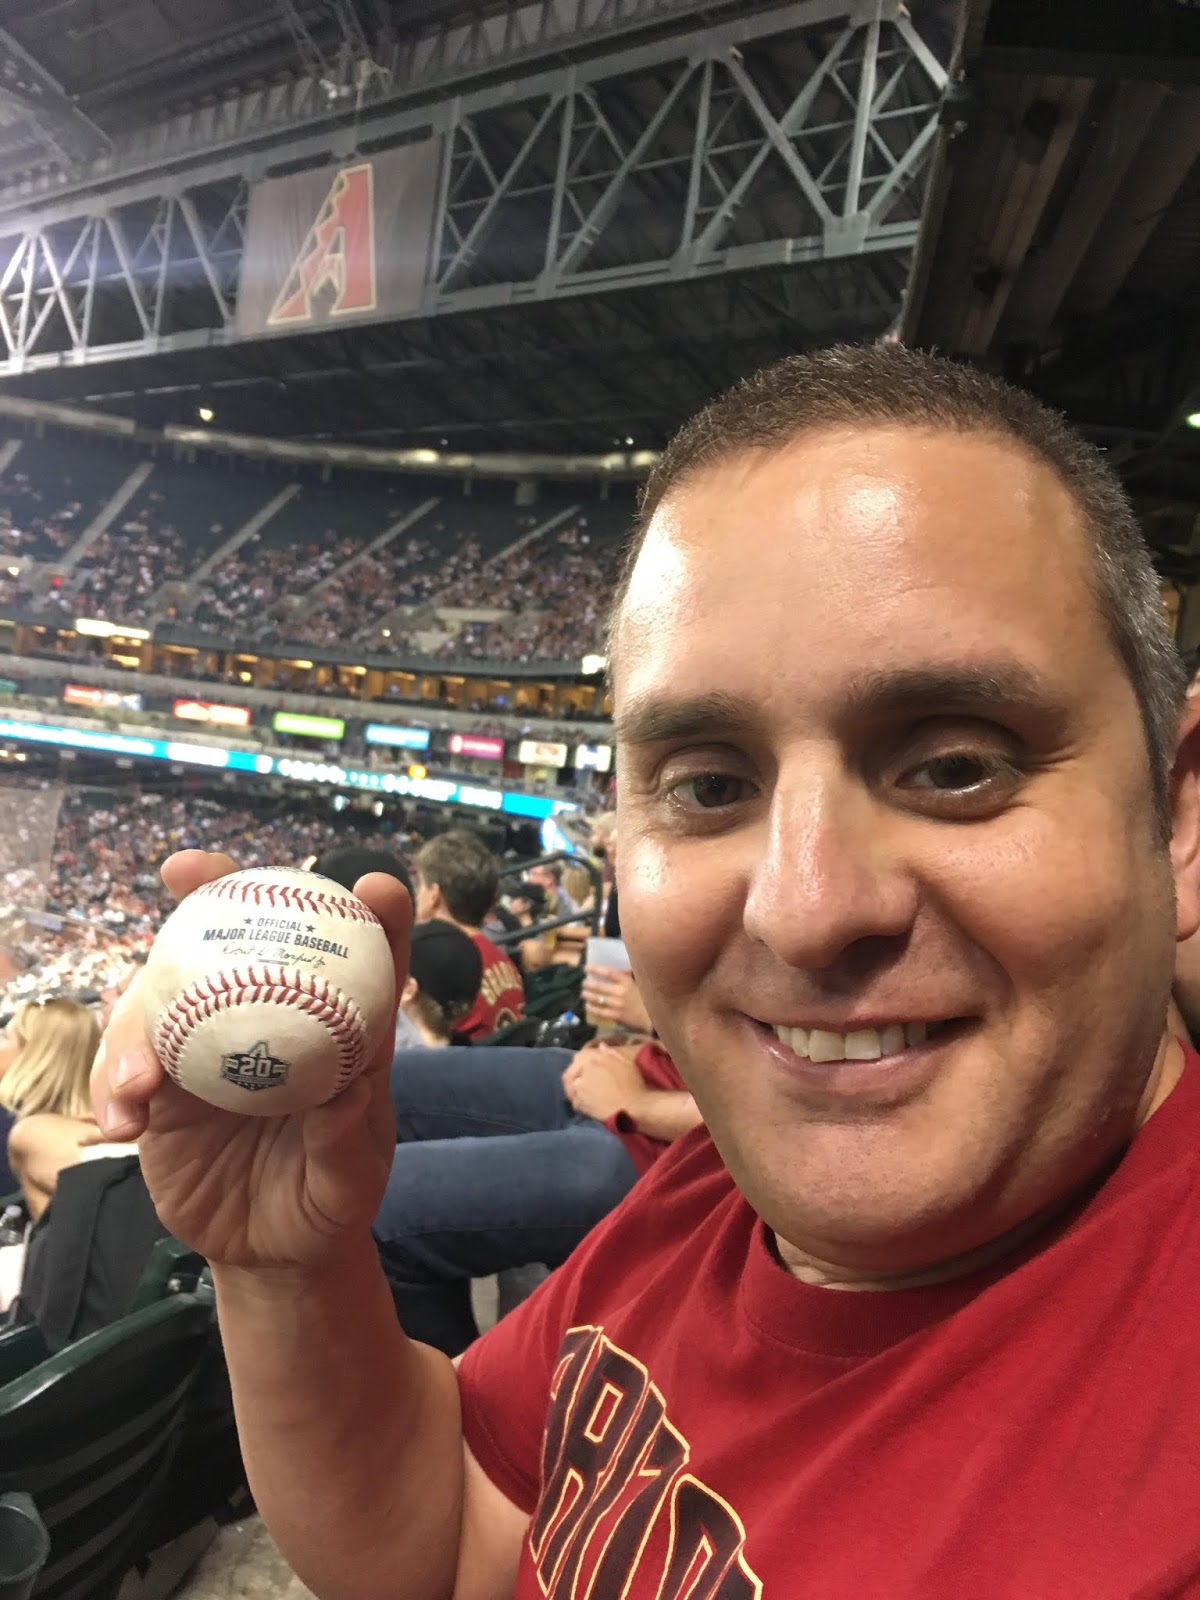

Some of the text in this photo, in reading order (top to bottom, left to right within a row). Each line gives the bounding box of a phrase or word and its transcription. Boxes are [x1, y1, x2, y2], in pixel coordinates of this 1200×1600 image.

[257, 917, 302, 932] OFFICIAL
[203, 928, 350, 959] MAJOR LEAGUE BASEBALL
[240, 1056, 272, 1077] 20
